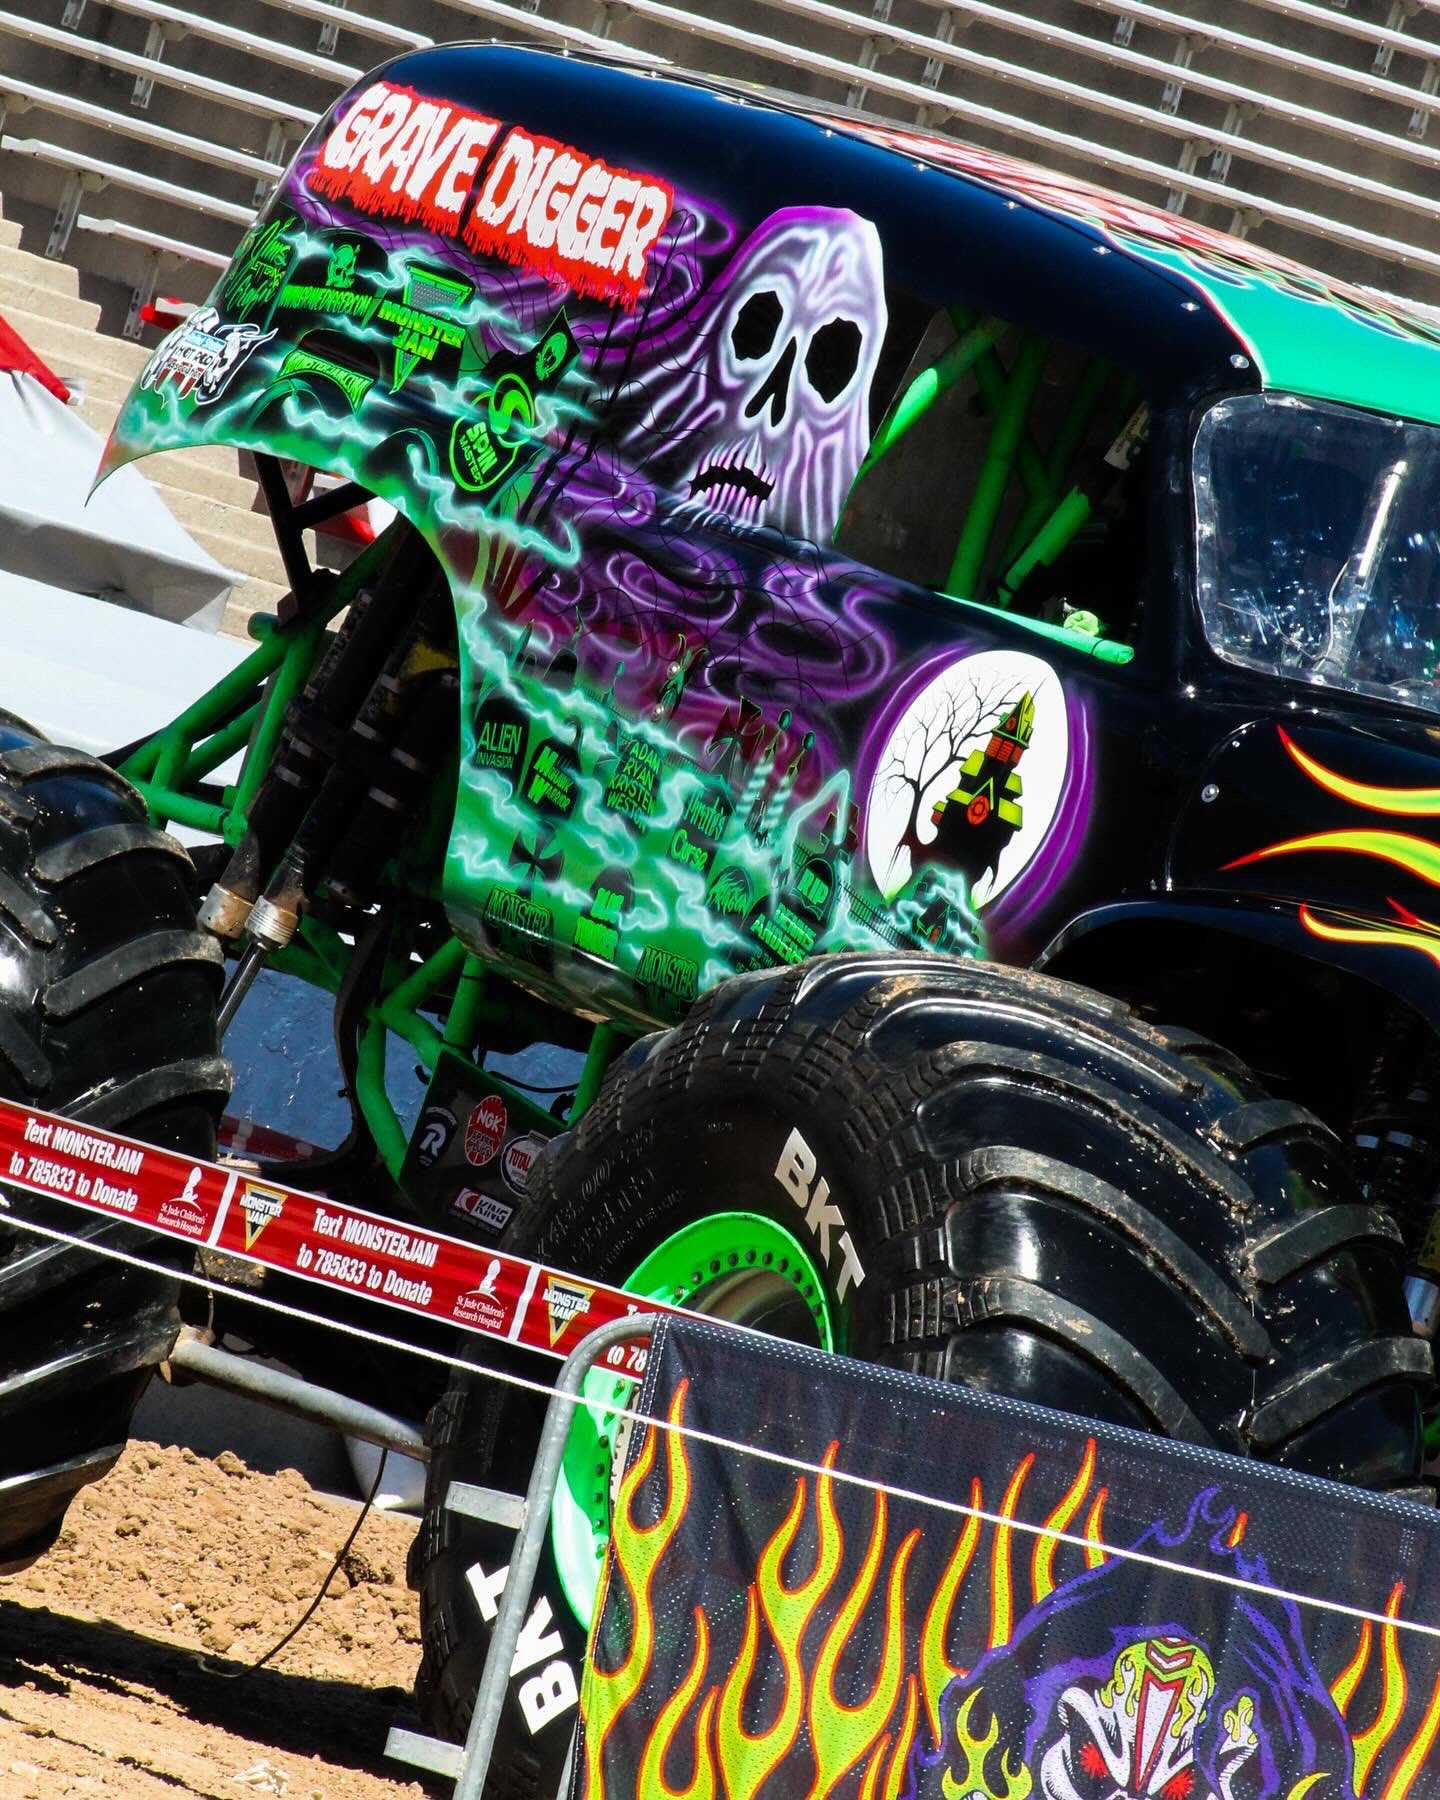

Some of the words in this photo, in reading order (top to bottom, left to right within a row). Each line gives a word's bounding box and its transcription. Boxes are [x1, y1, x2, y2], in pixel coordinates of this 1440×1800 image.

[324, 82, 497, 214] GRAVE
[475, 133, 668, 280] DIGGER
[378, 300, 466, 348] MONSTER
[392, 327, 439, 360] JAM
[459, 434, 483, 483] MASTER
[466, 421, 498, 475] SPIN
[477, 721, 523, 755] ALIEN
[476, 751, 514, 769] INVASION
[630, 739, 660, 772] ADAM
[623, 758, 655, 791] RYAN
[609, 774, 656, 815] KRYSTEN
[607, 792, 646, 833] WESTON
[671, 829, 709, 872] Curse
[797, 867, 829, 905] RIP
[487, 886, 551, 937] MONSTER
[750, 913, 809, 965] ANDERS
[638, 946, 698, 1000] MONSTER
[471, 1130, 493, 1145] SPARK
[476, 1110, 503, 1132] NGK
[23, 1117, 54, 1147] Text
[51, 1126, 145, 1176] MONSTERJAM
[509, 1148, 531, 1172] TOTAL
[9, 1151, 25, 1176] to
[26, 1156, 76, 1193] 785833
[75, 1173, 91, 1198] to
[91, 1177, 139, 1212] Donate
[168, 1205, 181, 1218] Jude
[179, 1208, 206, 1225] Children's
[239, 1194, 283, 1217] MONSTER
[247, 1210, 270, 1225] JAM
[475, 1199, 508, 1224] KING
[774, 1126, 866, 1305] BKT
[157, 1213, 181, 1230] Research
[180, 1219, 204, 1235] Hospital
[313, 1207, 343, 1238] Text
[340, 1217, 440, 1268] MONSTERJAM
[296, 1243, 313, 1268] to
[313, 1248, 367, 1285] 785833
[366, 1264, 383, 1290] to
[382, 1269, 432, 1306] Donate
[452, 1306, 478, 1323] Research
[476, 1311, 502, 1329] Hospital
[463, 1297, 478, 1311] Jude
[476, 1301, 505, 1319] Children's
[542, 1288, 591, 1313] MONSTER
[550, 1303, 576, 1320] JAM
[606, 1345, 625, 1366] to
[626, 1345, 648, 1373] 78
[465, 1561, 578, 1736] BKT
